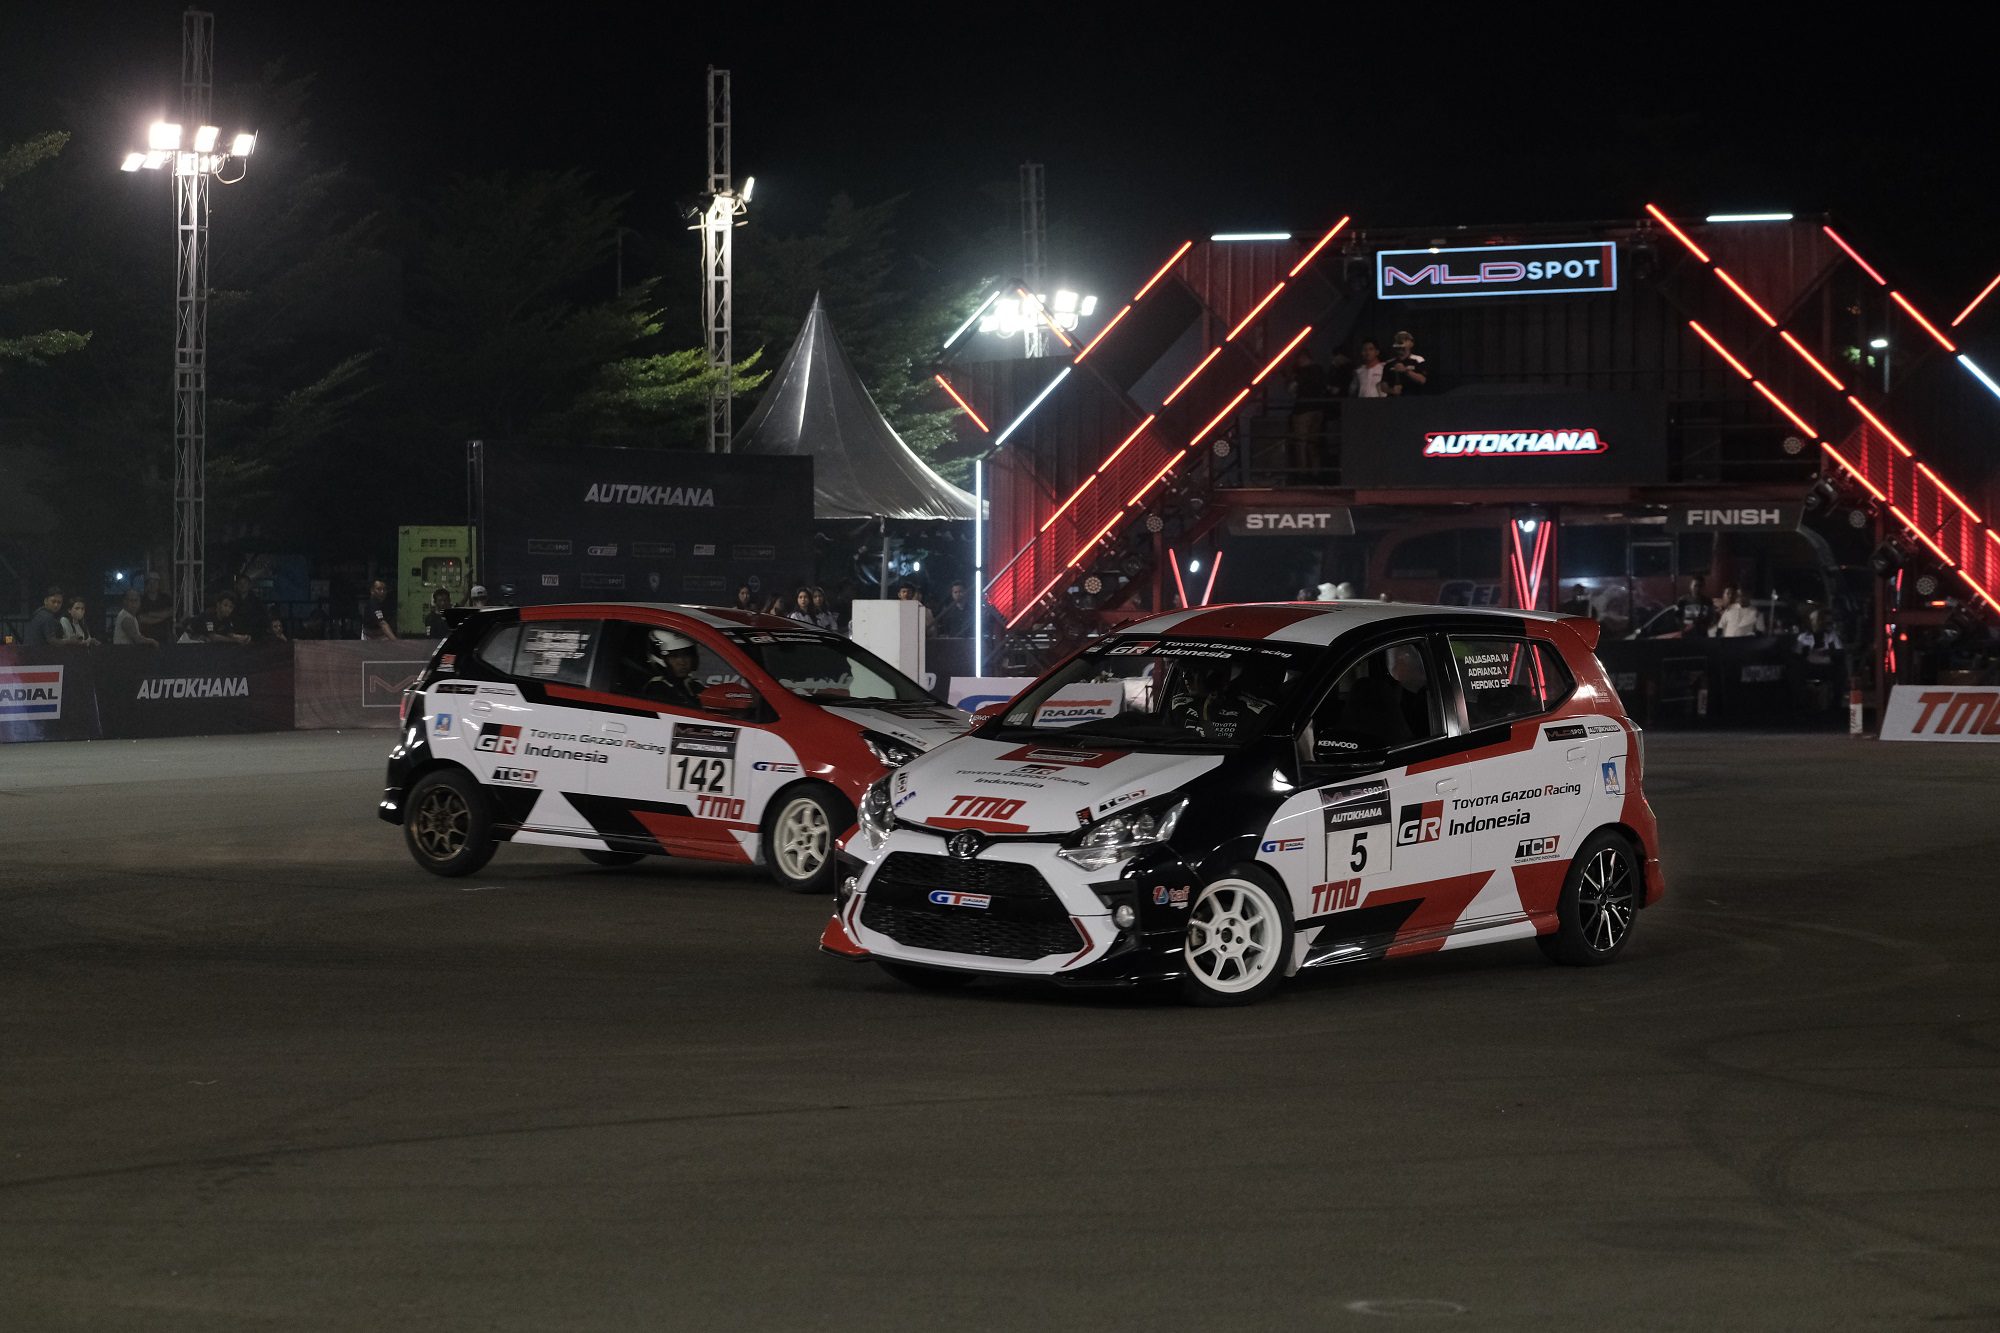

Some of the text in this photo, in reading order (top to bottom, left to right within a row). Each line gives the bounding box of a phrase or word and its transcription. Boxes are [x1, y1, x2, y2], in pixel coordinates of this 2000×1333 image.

[1426, 431, 1598, 454] AUTOKHANA
[584, 483, 714, 507] AUTOKHANA
[1246, 512, 1331, 530] START
[1687, 508, 1780, 525] FINISH
[1110, 646, 1149, 656] GR
[1152, 647, 1233, 659] Indonesia
[1464, 654, 1501, 664] ANJASARA
[1468, 665, 1508, 677] ADRIANZA Y
[136, 677, 249, 700] AUTOKHANA
[1471, 680, 1500, 690] HERDIKO
[0, 688, 58, 702] ADIAL
[1041, 706, 1107, 717] RADIAL
[475, 734, 519, 755] GR
[530, 729, 666, 755] TOYOTA GAZOO Racing
[1317, 739, 1358, 750] KENWOOD
[524, 744, 609, 764] Indonesia
[496, 767, 535, 783] TCD
[677, 757, 725, 792] 142
[1013, 767, 1055, 776] GR
[974, 778, 1045, 789] Indonesia
[1049, 777, 1090, 786] Racing
[1101, 790, 1145, 808] TCD
[1453, 782, 1581, 811] TOYOTA GAZOO Racing
[697, 794, 745, 821] TMO
[945, 795, 1026, 821] TMO
[1331, 807, 1383, 824] AUTOKHANA
[1397, 816, 1441, 845] GR
[1449, 809, 1531, 837] Indonesia
[1350, 832, 1369, 873] 5
[1518, 836, 1557, 857] TCD
[930, 891, 962, 904] GT
[1312, 878, 1361, 915] TMO
